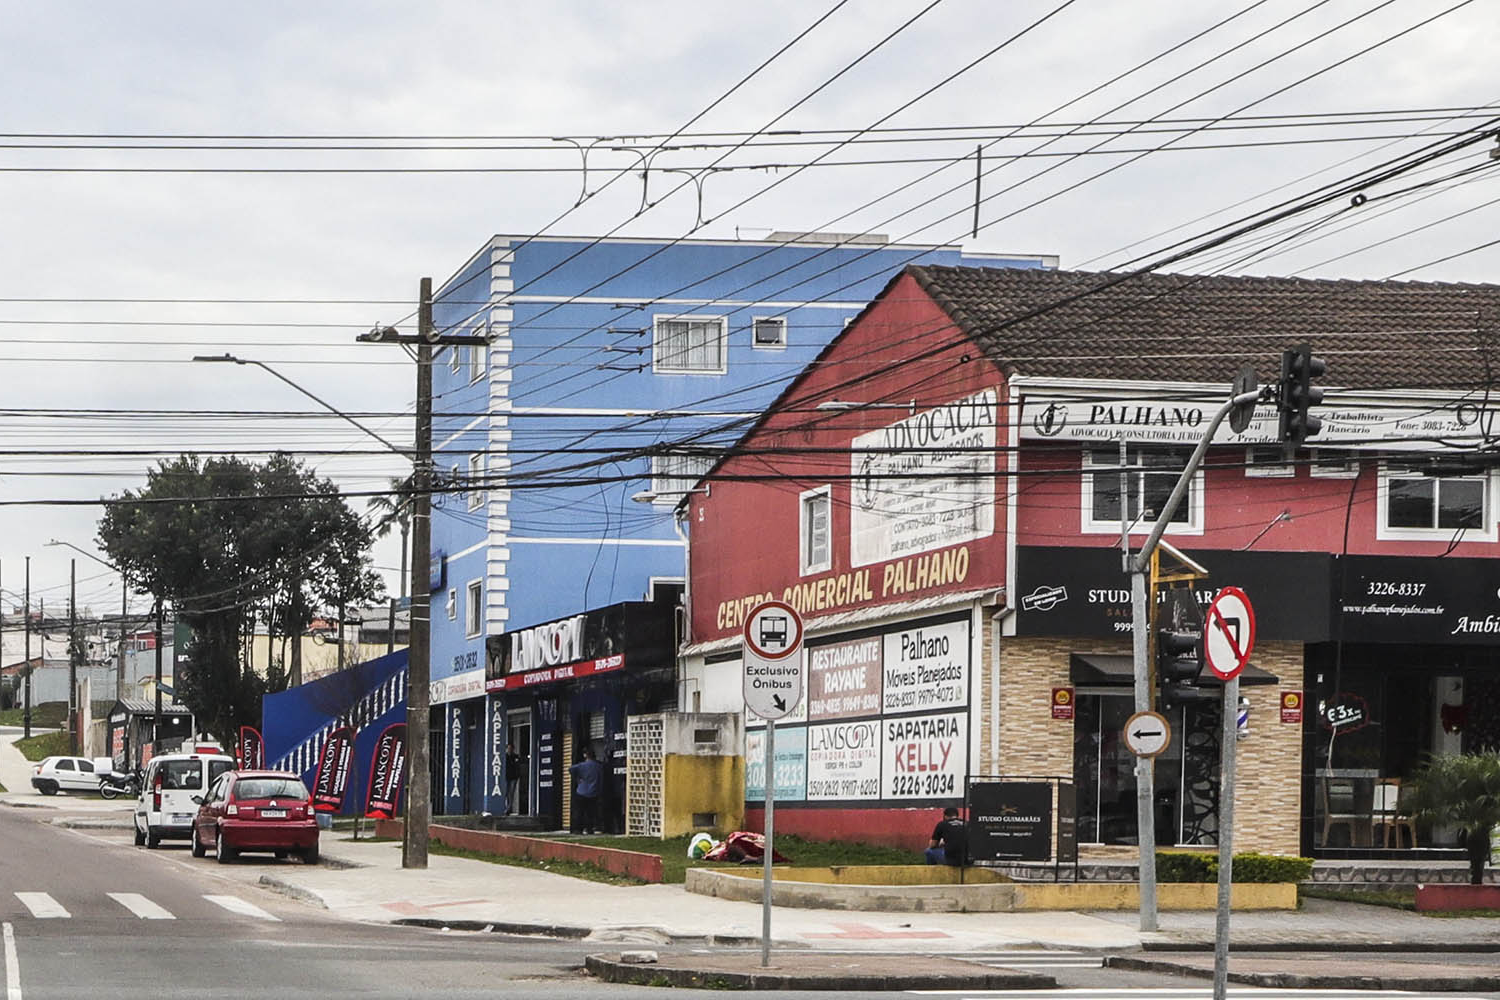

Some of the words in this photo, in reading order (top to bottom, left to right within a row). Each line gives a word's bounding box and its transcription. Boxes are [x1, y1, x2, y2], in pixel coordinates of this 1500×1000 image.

[884, 391, 993, 456] ADVOCACIA
[1088, 405, 1203, 427] PALHANO
[1327, 424, 1371, 435] Bancário
[1330, 412, 1384, 422] Trabalhista
[1395, 420, 1419, 431] Fone:
[1069, 428, 1115, 439] ADVOCACIA
[1177, 430, 1208, 442] JURÍD
[888, 454, 924, 475] PALHANO
[783, 569, 873, 613] COMERCIAL
[883, 546, 969, 597] PALHANO
[1367, 582, 1426, 596] 3226-8337
[510, 615, 587, 673] LAMSCOPY
[812, 641, 879, 671] RESTAURANTE
[901, 630, 949, 662] Palhano
[746, 666, 799, 676] Exclusivo
[753, 678, 792, 689] Ônibus
[824, 666, 867, 694] RAYANE
[886, 667, 915, 689] Móveis
[917, 661, 962, 688] Planejados
[811, 724, 878, 751] LAMSCOPY
[889, 717, 958, 741] SAPATARIA
[451, 708, 461, 797] PAPELARIA
[492, 701, 502, 796] PAPELARIA
[810, 751, 846, 761] COPIADORA
[851, 749, 877, 760] DIGITAL
[895, 741, 952, 772] KELLY
[318, 739, 337, 793] LAMSCOPY
[373, 734, 393, 798] LAMSCOPY
